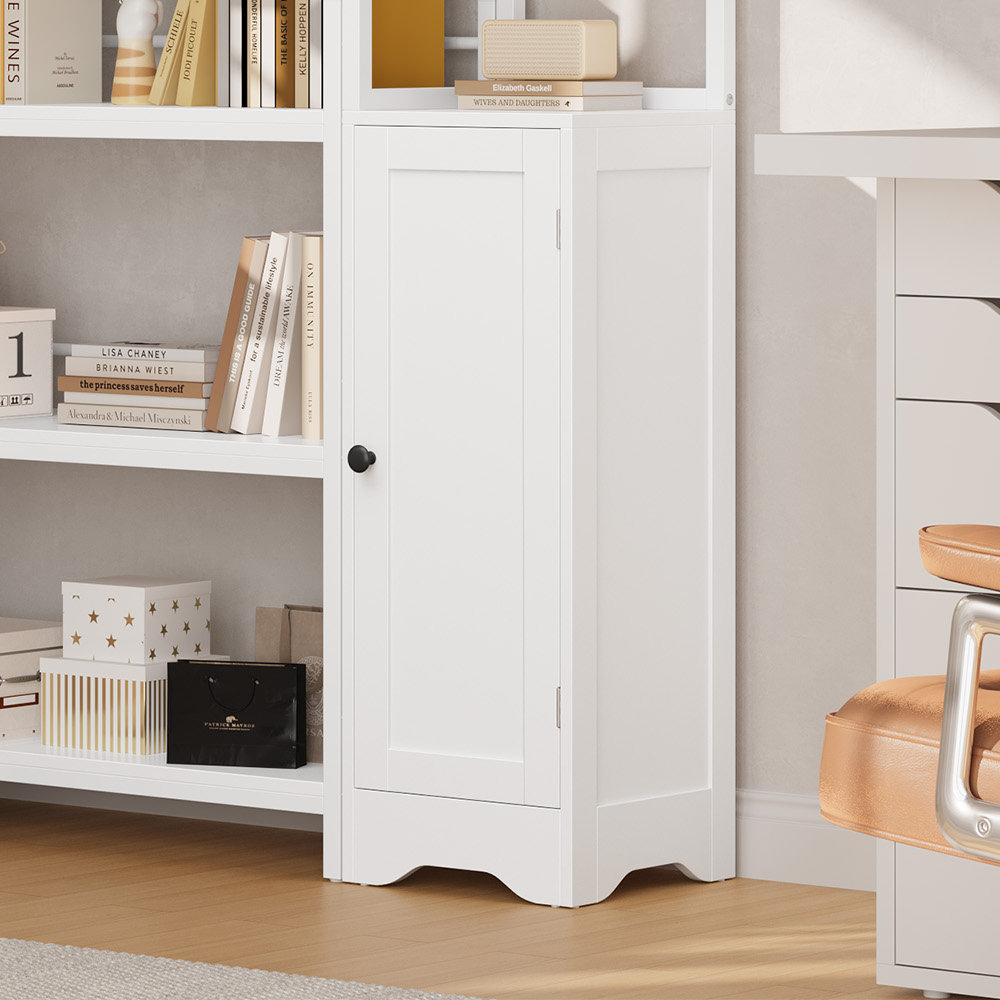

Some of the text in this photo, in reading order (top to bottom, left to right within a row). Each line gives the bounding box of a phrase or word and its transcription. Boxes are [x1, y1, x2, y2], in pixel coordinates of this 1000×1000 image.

[280, 5, 288, 17] OF
[299, 2, 307, 43] HOPPEN
[165, 10, 184, 54] SCHIELE
[280, 19, 288, 46] BASIC
[7, 20, 20, 83] WINES
[183, 19, 198, 80] JODI PICOULT
[280, 48, 288, 66] THE
[299, 45, 307, 76] KELLY
[492, 83, 553, 92] Elizabeth Gaskell
[515, 99, 560, 107] DAUGHTERS
[307, 262, 314, 278] ON
[255, 292, 270, 340] sustainable
[265, 257, 278, 291] lifestyle
[284, 285, 294, 319] AWAKE
[228, 283, 255, 383] THIS IS A GOOD GUIDE
[281, 319, 289, 339] world
[8, 332, 32, 378] 1
[102, 348, 167, 359] LISA CHANEY
[96, 364, 174, 375] BRIANNA WIEST
[273, 350, 285, 387] DREAM
[80, 380, 184, 394] the princess saves herself
[67, 409, 106, 421] Alexandra
[106, 412, 113, 421] &
[114, 411, 146, 422] Michael
